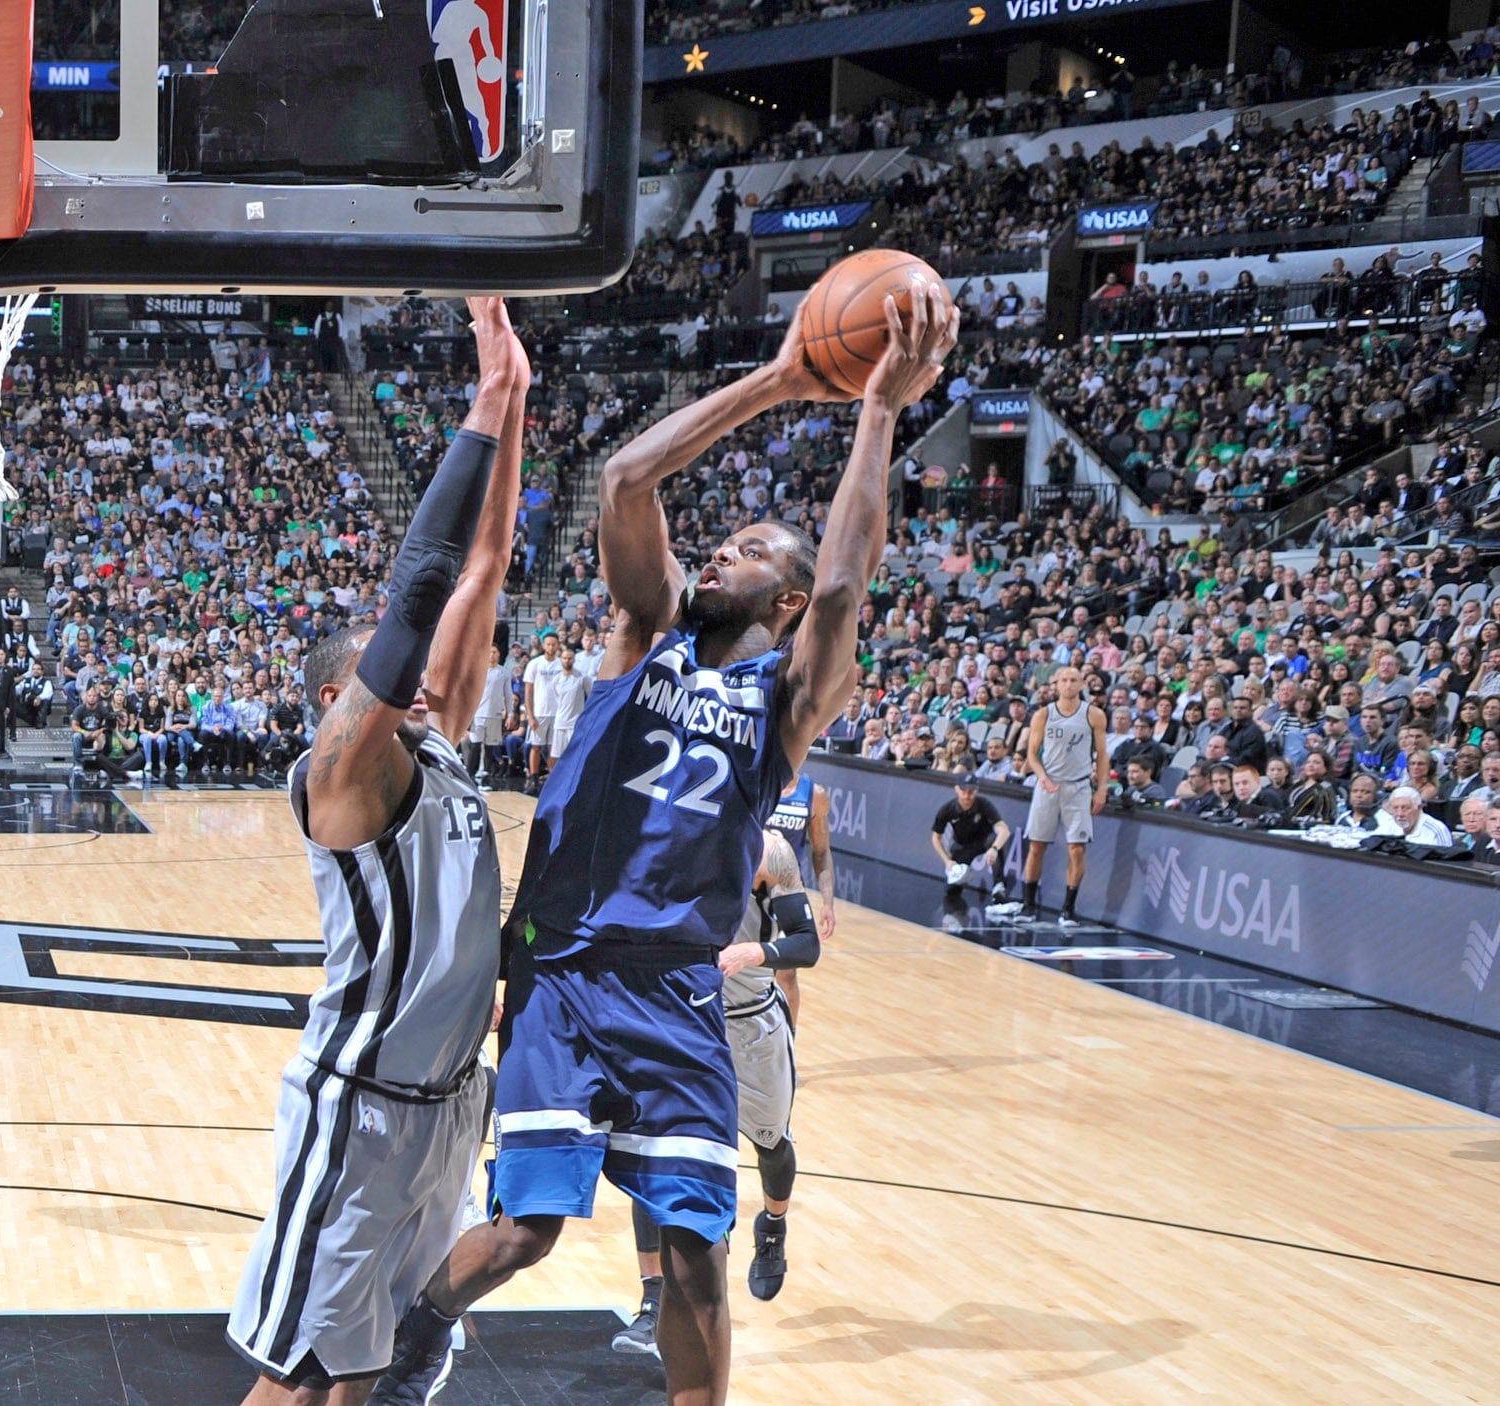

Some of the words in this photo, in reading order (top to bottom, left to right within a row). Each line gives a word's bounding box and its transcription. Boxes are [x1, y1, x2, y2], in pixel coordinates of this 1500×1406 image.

[48, 67, 90, 86] MIN
[801, 210, 838, 229] USAA
[1104, 209, 1149, 229] USAA
[207, 299, 242, 315] BUMS
[996, 400, 1030, 415] USAA
[634, 673, 757, 750] MINNESOTA
[1046, 727, 1064, 739] 20
[623, 729, 728, 816] 22
[442, 795, 484, 842] 12
[827, 785, 867, 840] SAA
[1194, 865, 1300, 952] USAA
